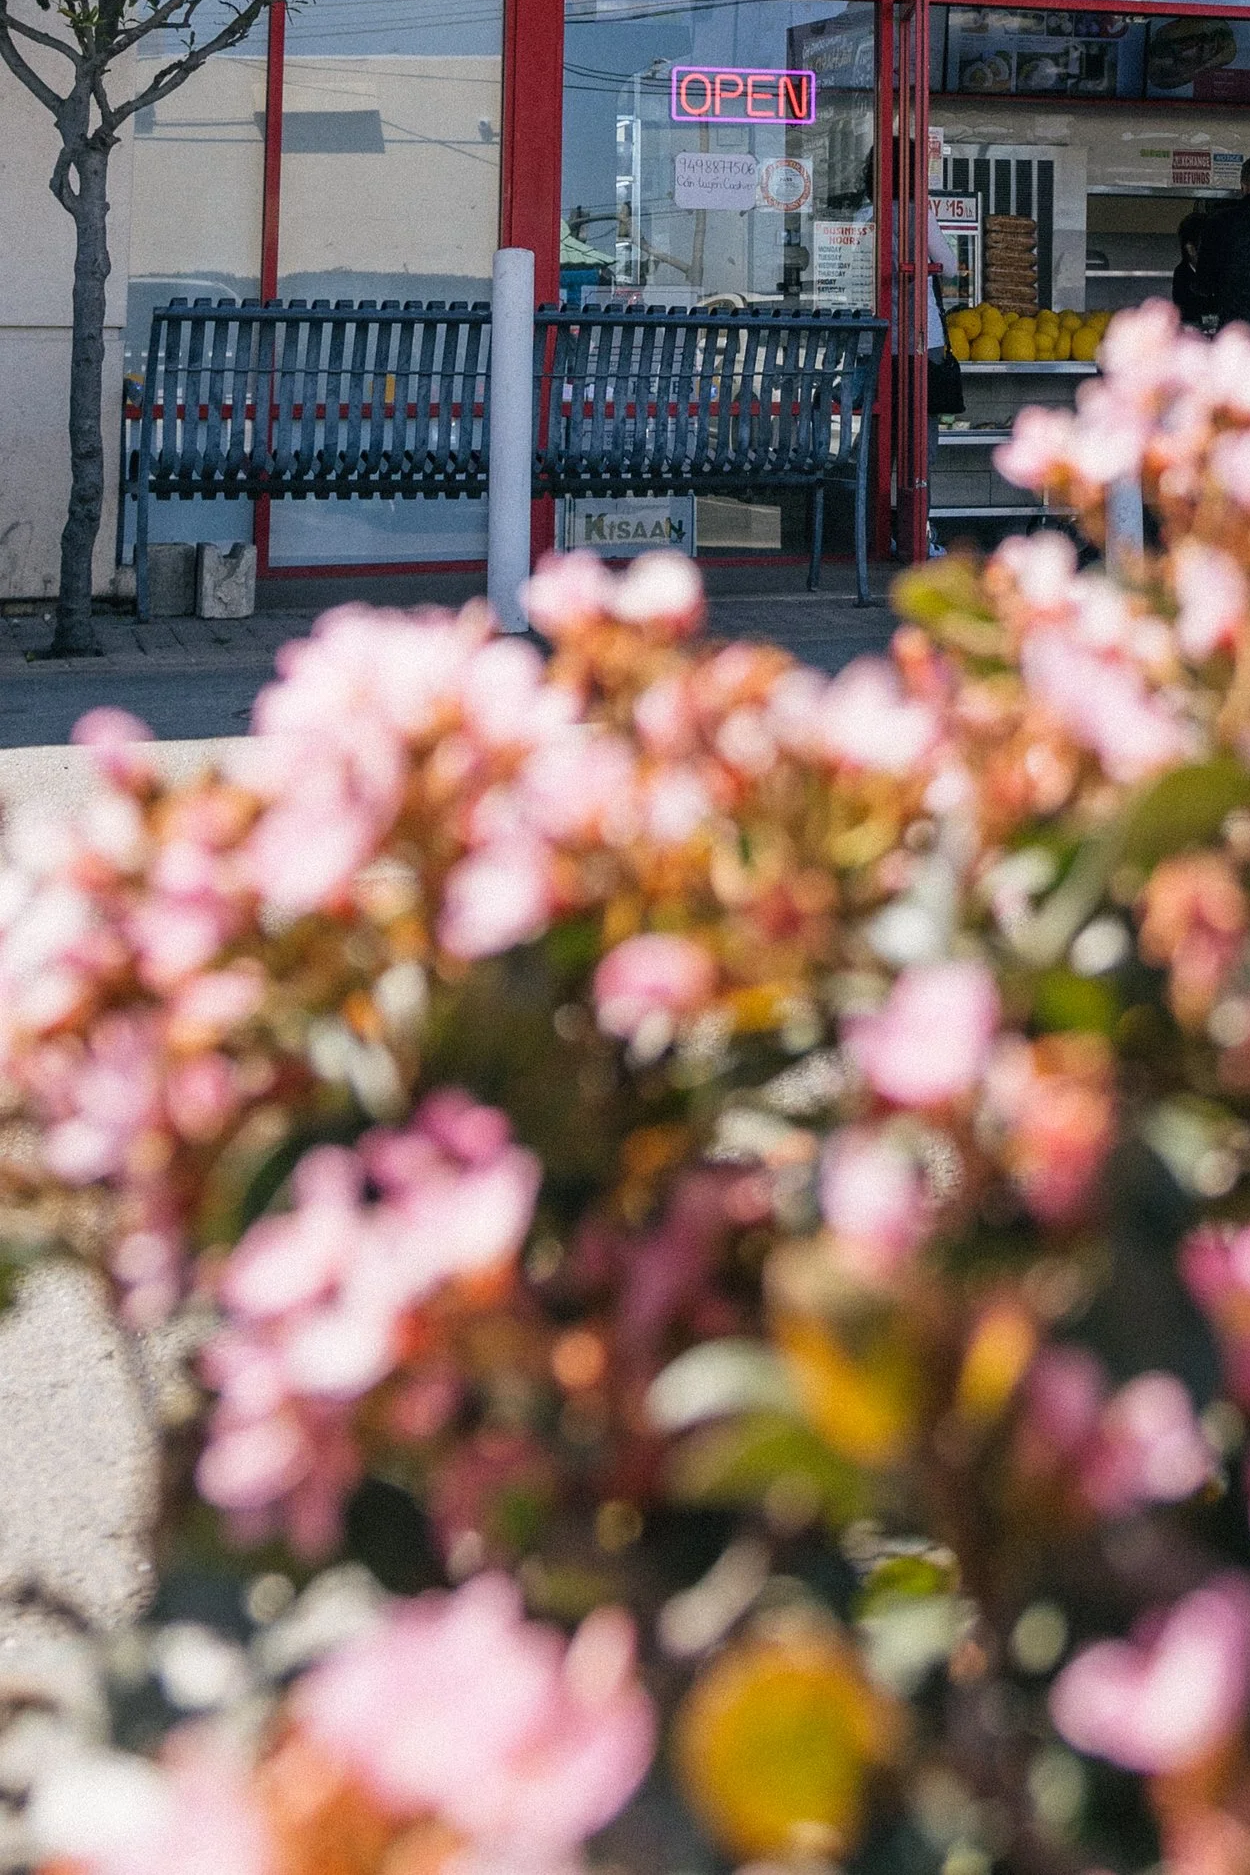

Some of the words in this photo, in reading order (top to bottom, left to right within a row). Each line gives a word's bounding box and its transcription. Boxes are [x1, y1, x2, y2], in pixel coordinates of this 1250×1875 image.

[680, 73, 808, 118] OPEN
[823, 226, 868, 236] BUSINESS
[828, 236, 861, 245] HOURS
